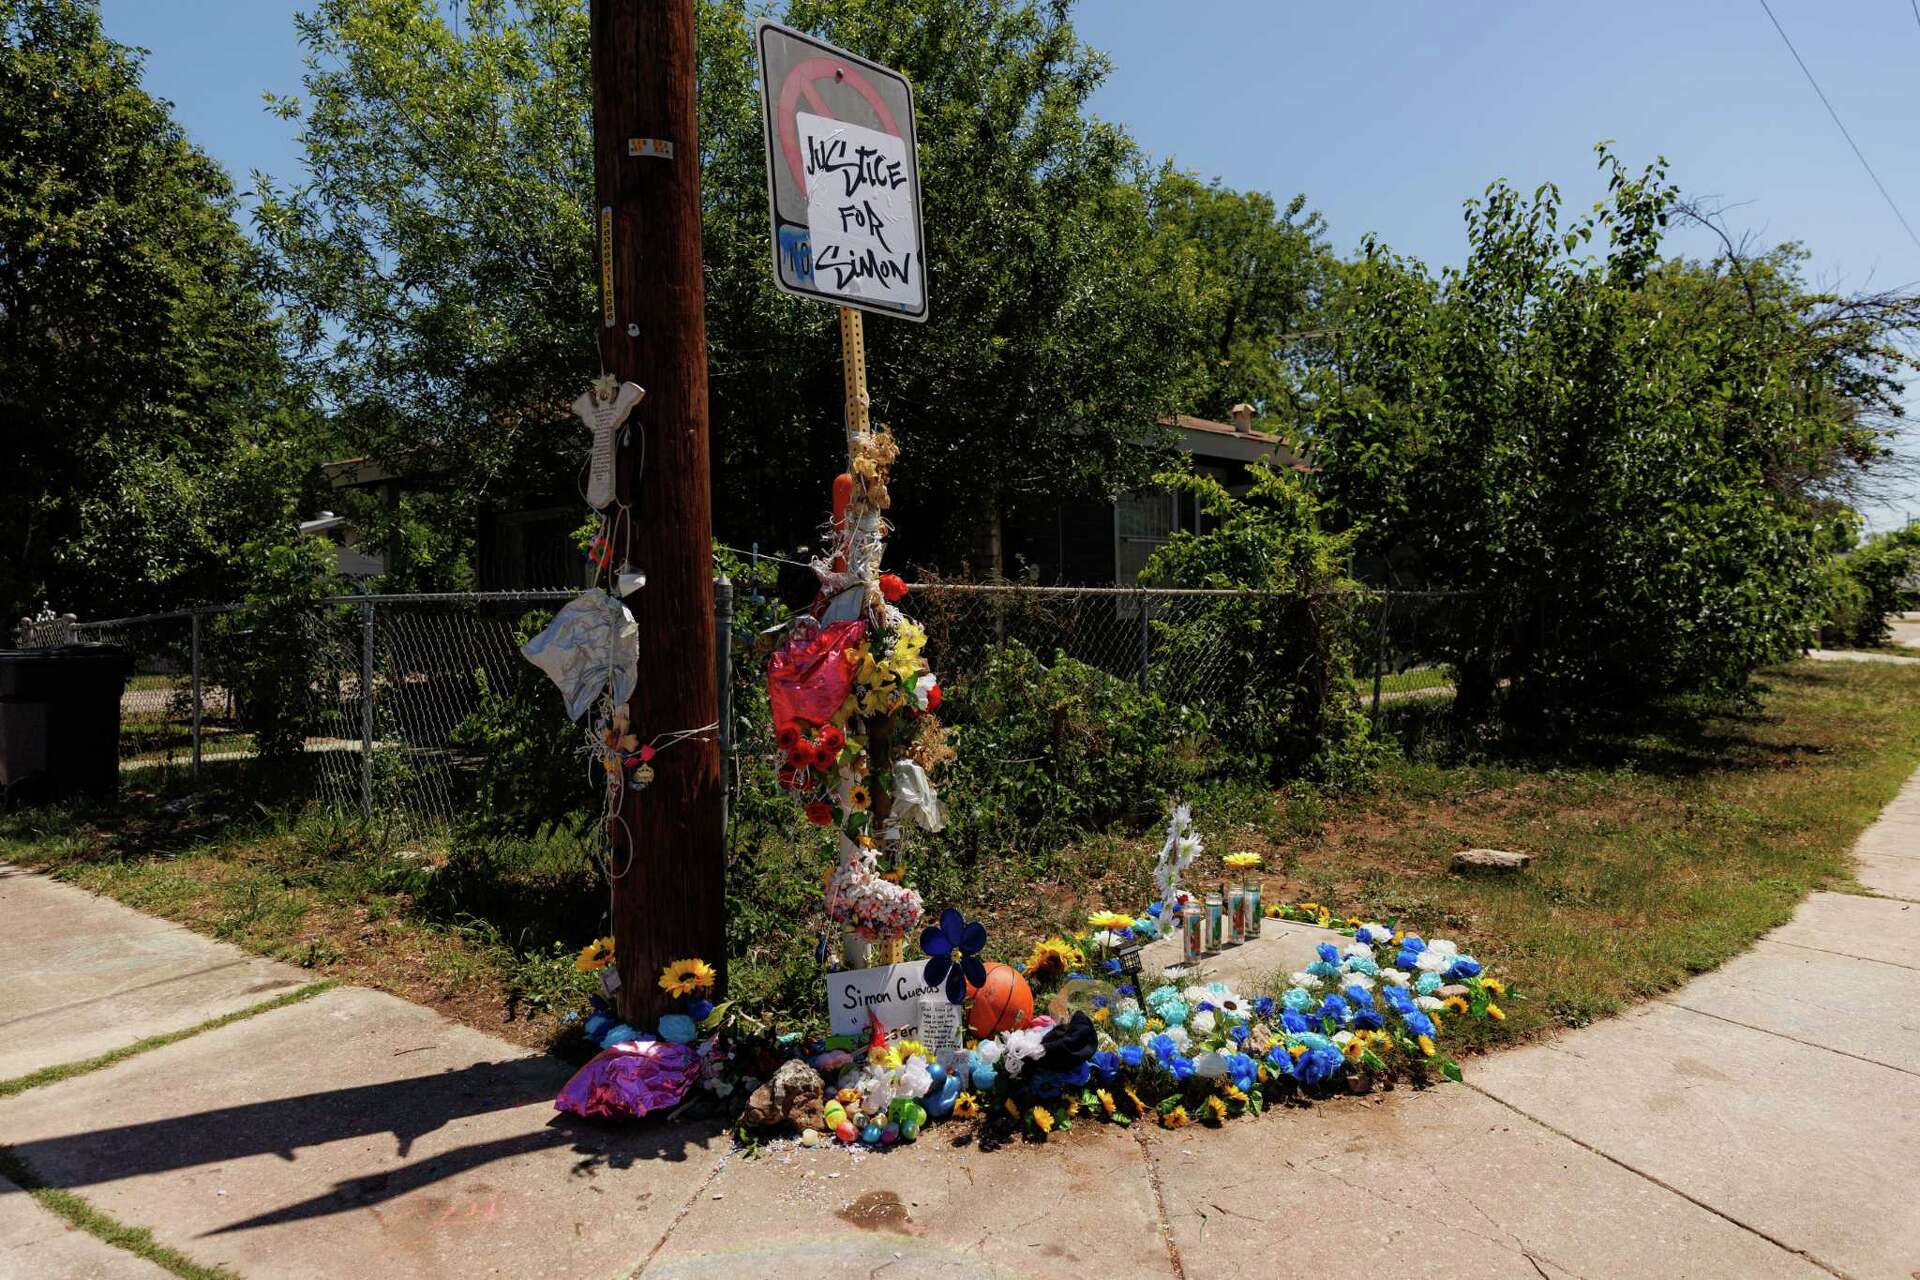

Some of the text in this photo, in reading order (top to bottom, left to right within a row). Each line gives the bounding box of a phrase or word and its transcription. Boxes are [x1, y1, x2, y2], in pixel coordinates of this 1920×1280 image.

[807, 136, 907, 198] JUSTICE
[838, 200, 893, 253] FOR
[843, 984, 892, 1010] Simon
